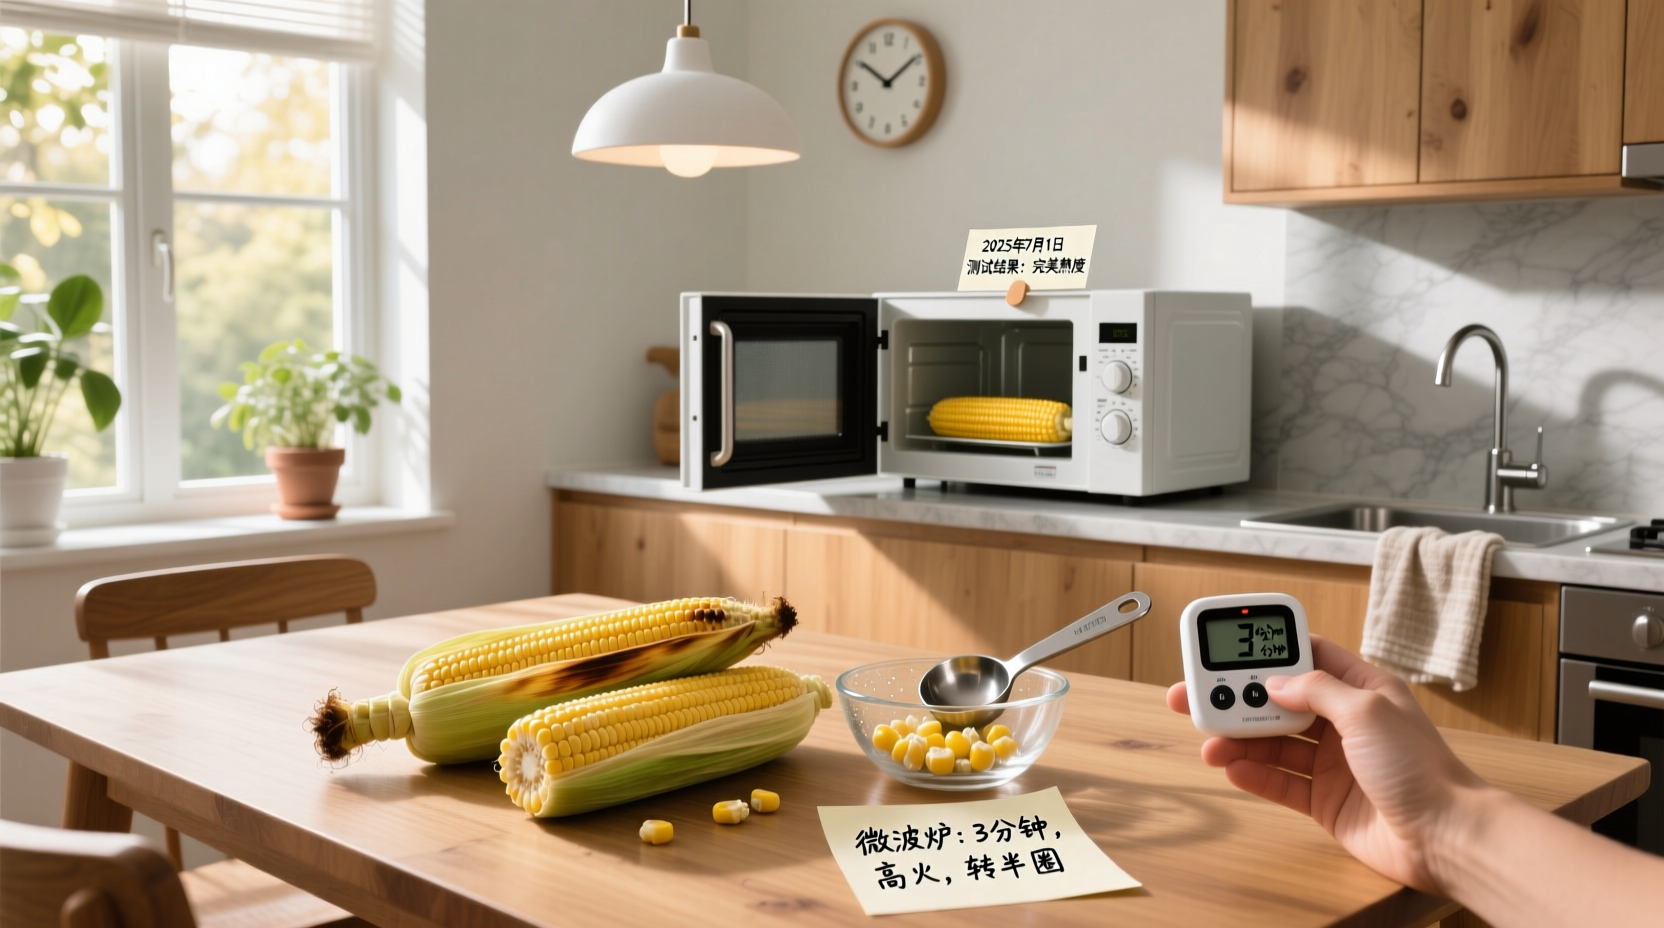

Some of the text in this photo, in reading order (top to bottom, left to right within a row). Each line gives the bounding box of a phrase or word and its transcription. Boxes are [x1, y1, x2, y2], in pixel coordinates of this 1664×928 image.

[981, 236, 1064, 254] 2025年7月1日
[1237, 623, 1254, 658] 3
[855, 814, 1062, 857] 微波炉：3分钟，
